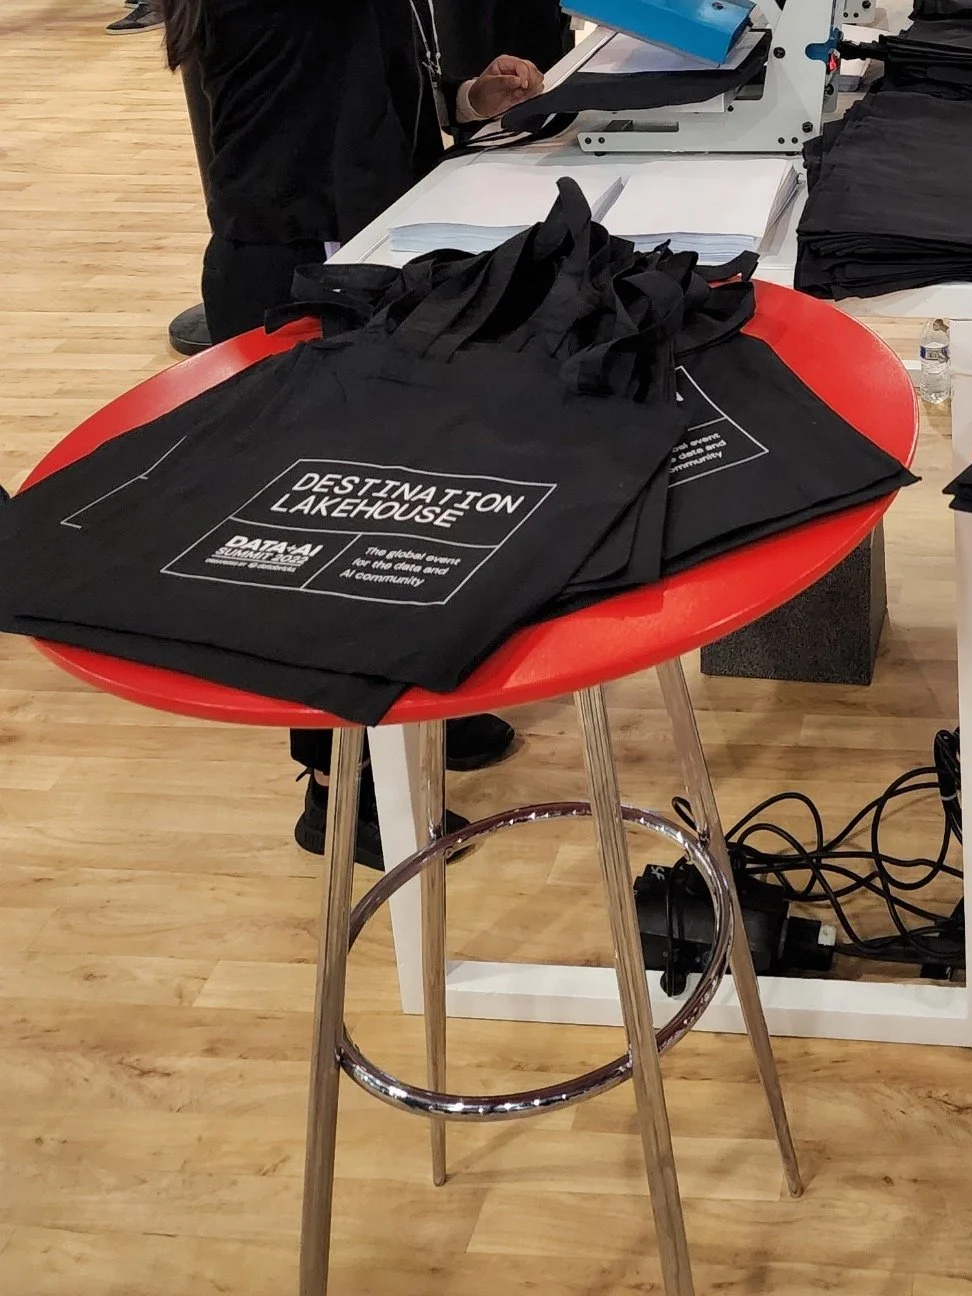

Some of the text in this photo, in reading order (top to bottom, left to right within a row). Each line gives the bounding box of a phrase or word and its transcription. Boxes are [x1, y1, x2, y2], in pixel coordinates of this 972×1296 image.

[690, 432, 720, 446] event
[678, 447, 704, 460] data
[705, 439, 727, 451] and
[669, 451, 722, 473] ommunity
[291, 472, 525, 514] DESTINATION
[270, 493, 465, 528] LAKEHOUSE
[215, 546, 310, 565] SUMMIT 2022
[224, 535, 324, 557] DATA+AI
[365, 547, 461, 565] The global event
[352, 558, 450, 575] for the data and
[339, 569, 425, 588] AI community
